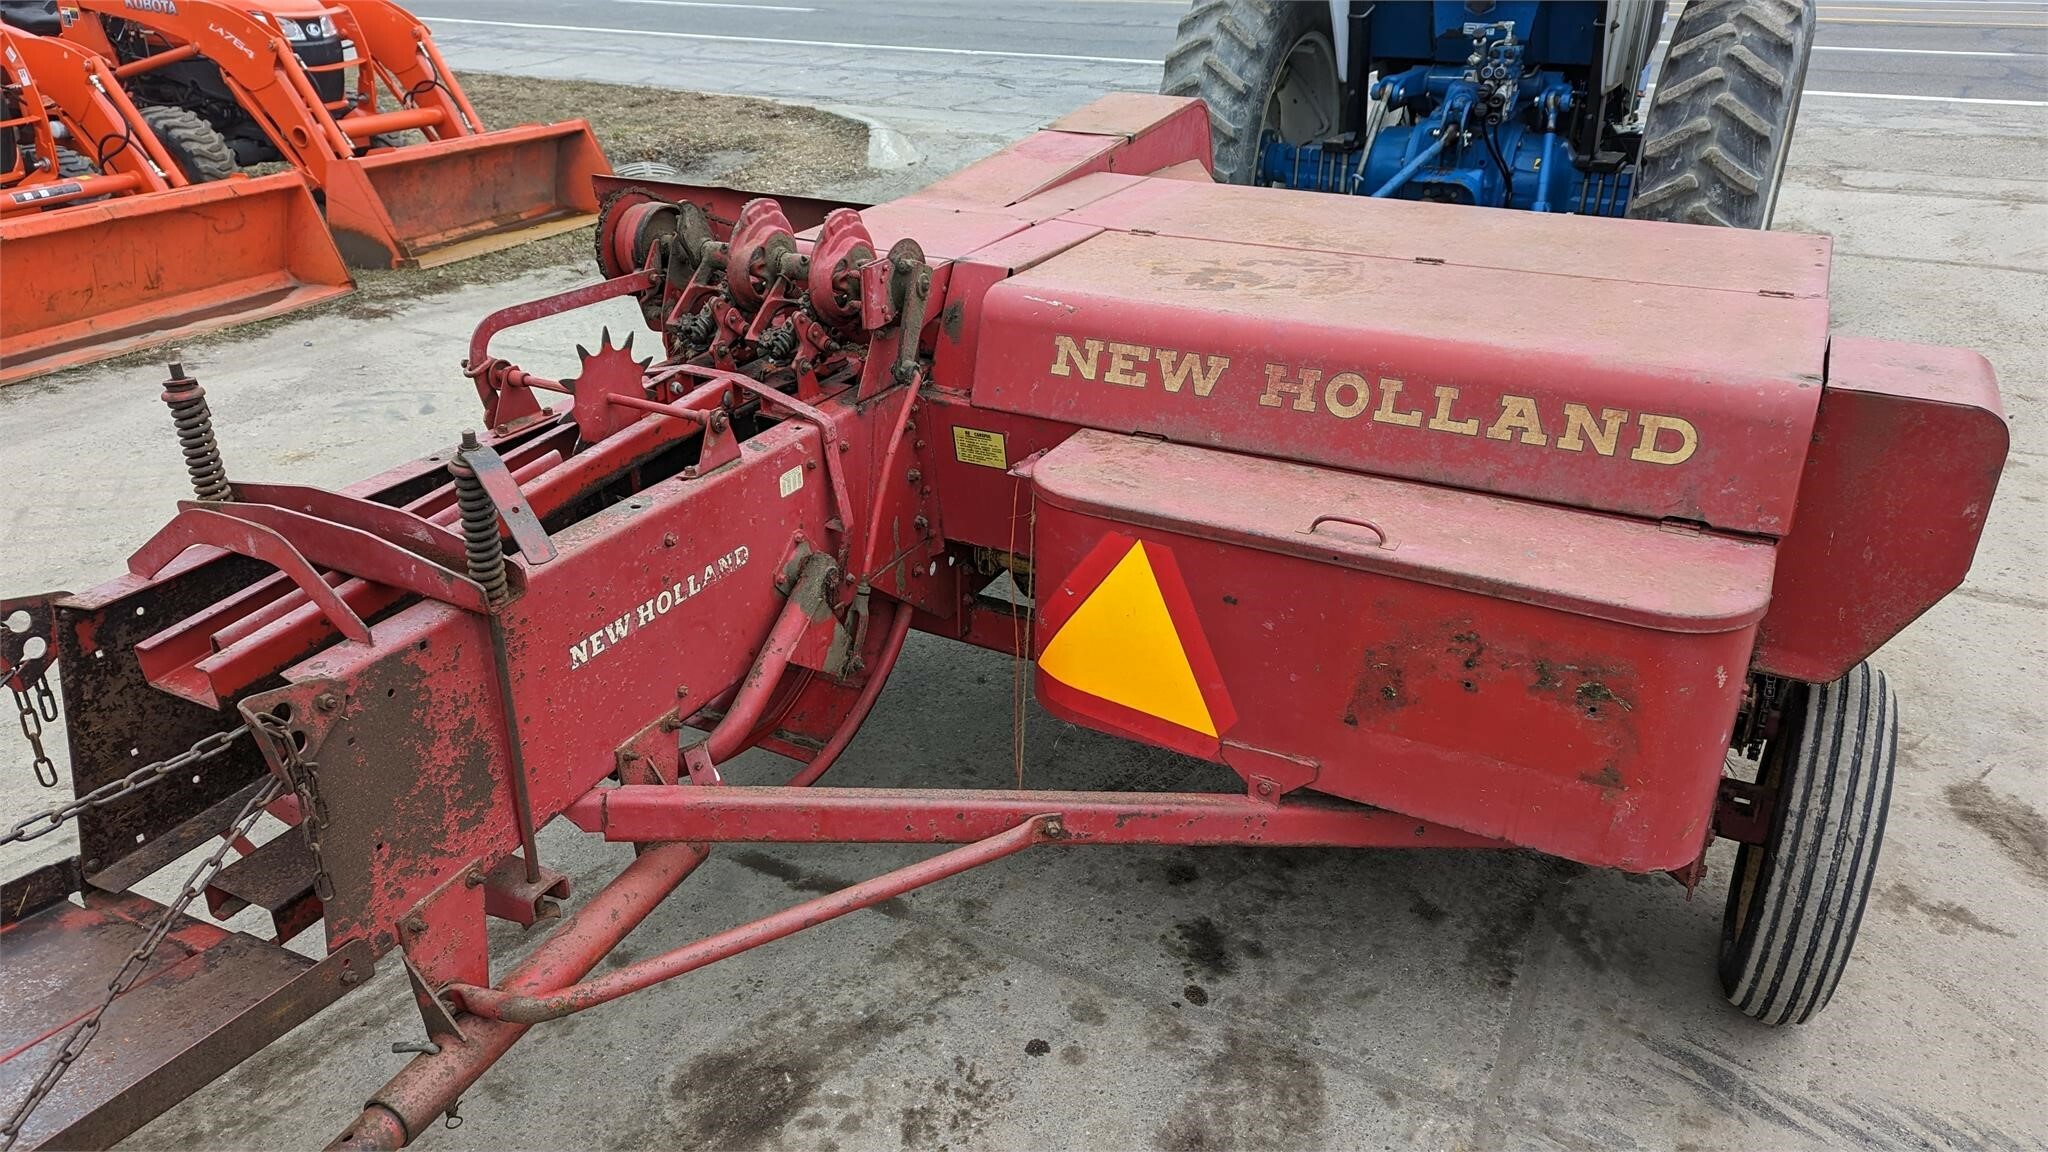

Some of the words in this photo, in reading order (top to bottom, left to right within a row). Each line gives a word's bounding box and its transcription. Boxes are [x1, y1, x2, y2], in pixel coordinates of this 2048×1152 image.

[124, 0, 178, 14] KUBOTA
[1050, 333, 1229, 397] NEW
[1259, 362, 1699, 466] HOLLAND
[569, 612, 631, 671] NEW
[636, 545, 750, 628] HOLLAND
